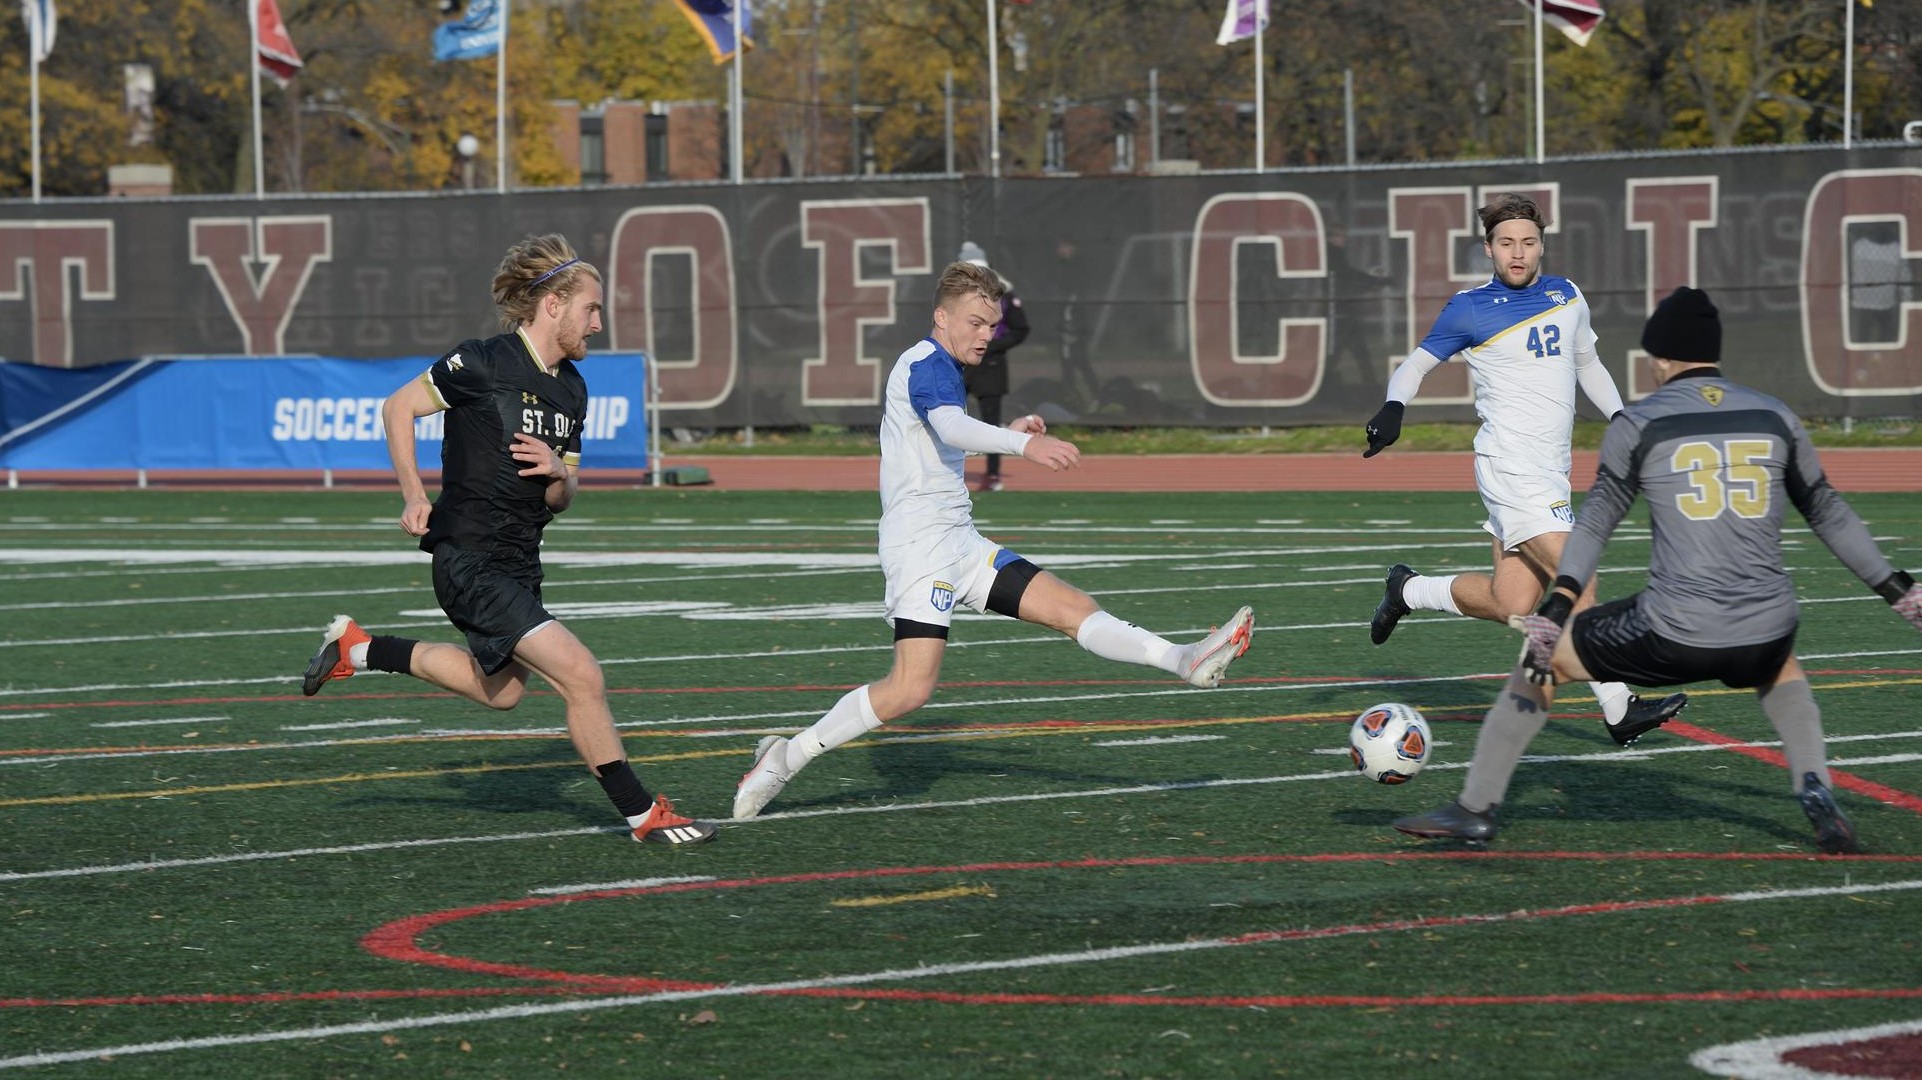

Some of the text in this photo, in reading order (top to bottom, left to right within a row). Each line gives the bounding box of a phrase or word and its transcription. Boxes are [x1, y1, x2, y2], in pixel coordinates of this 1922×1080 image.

[609, 198, 932, 409] OF
[1526, 324, 1561, 358] 42
[522, 408, 549, 436] ST.
[1671, 440, 1773, 520] 35
